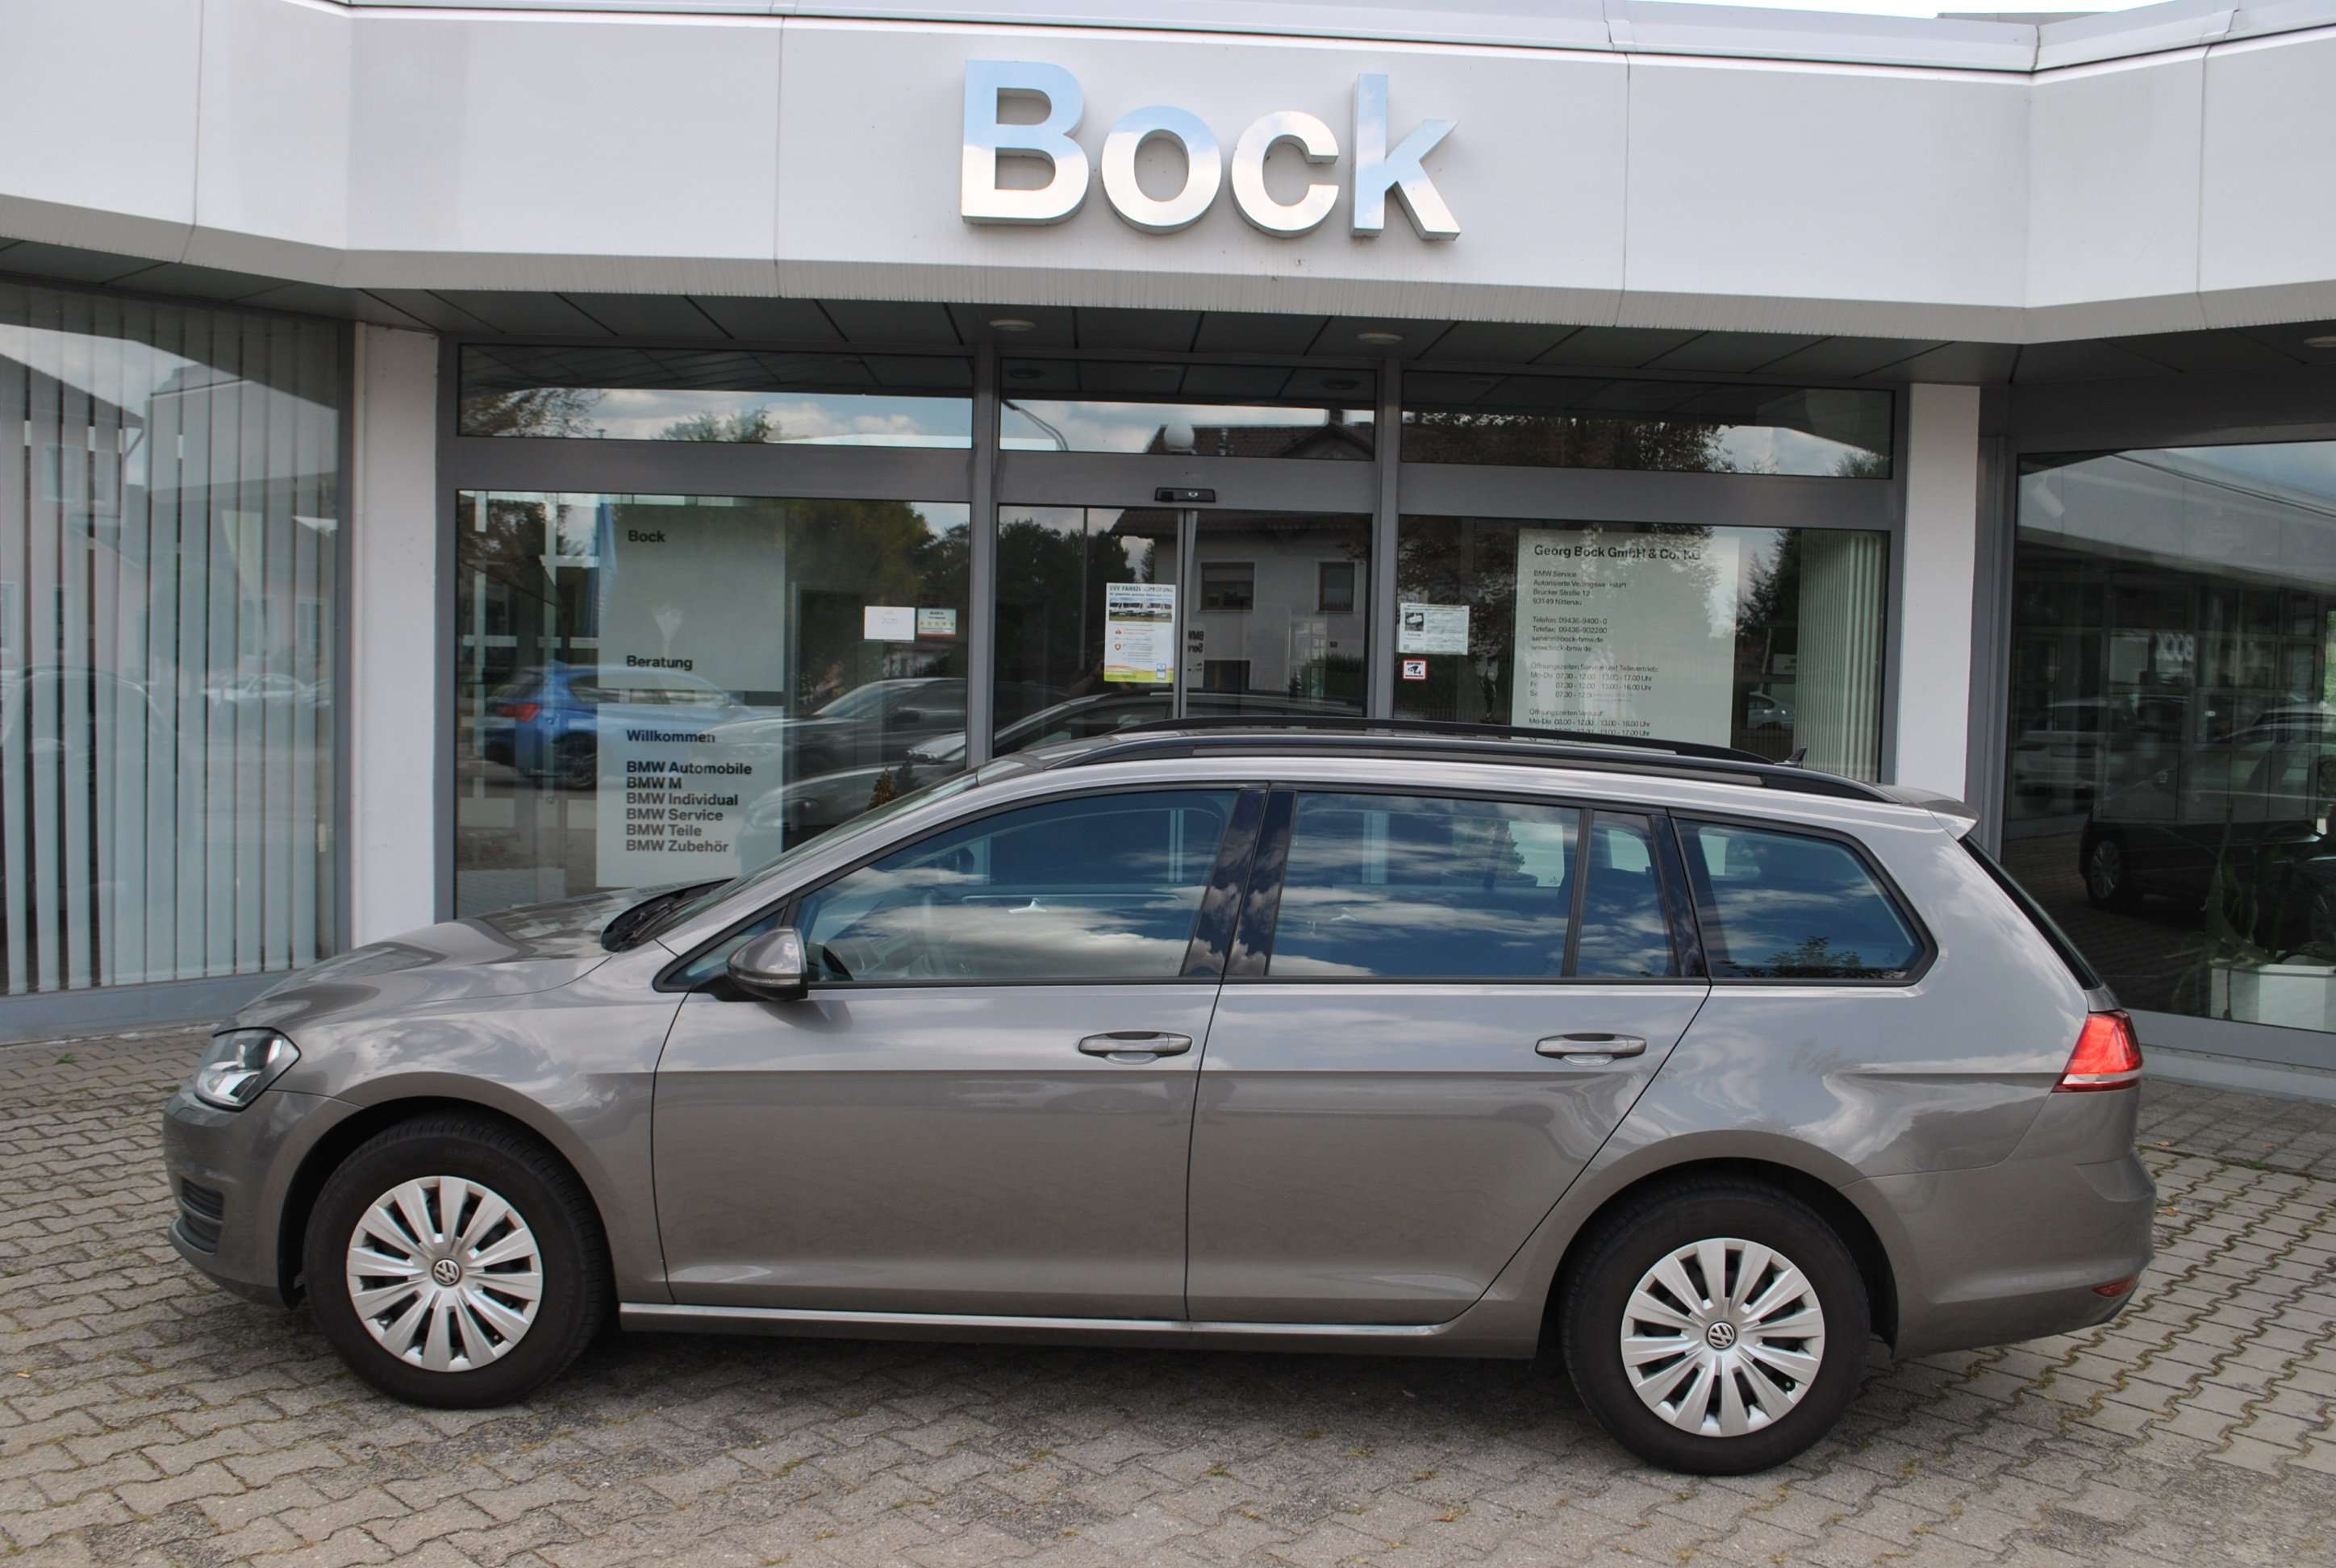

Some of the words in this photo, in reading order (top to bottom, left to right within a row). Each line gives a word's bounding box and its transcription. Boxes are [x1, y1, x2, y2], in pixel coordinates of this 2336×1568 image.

[961, 59, 1461, 240] Bock
[628, 529, 665, 542] Bock
[1534, 544, 1571, 558] Georg
[1574, 545, 1604, 557] Bock
[1608, 547, 1645, 558] GmbH
[1648, 548, 1657, 559] &
[1660, 548, 1679, 560] Co.
[626, 655, 693, 671] Beratung
[626, 729, 715, 743] Willkommen
[626, 761, 665, 773] BMW
[669, 761, 753, 774] Automobile
[626, 777, 665, 789] BMW
[669, 777, 682, 789] M
[626, 792, 665, 804] BMW
[669, 793, 738, 806] Individual
[626, 808, 665, 820] BMW
[668, 808, 724, 821] Service
[626, 824, 665, 836] BMW
[668, 824, 702, 836] Teile
[626, 840, 665, 851] BMW
[668, 840, 729, 853] Zubehör
